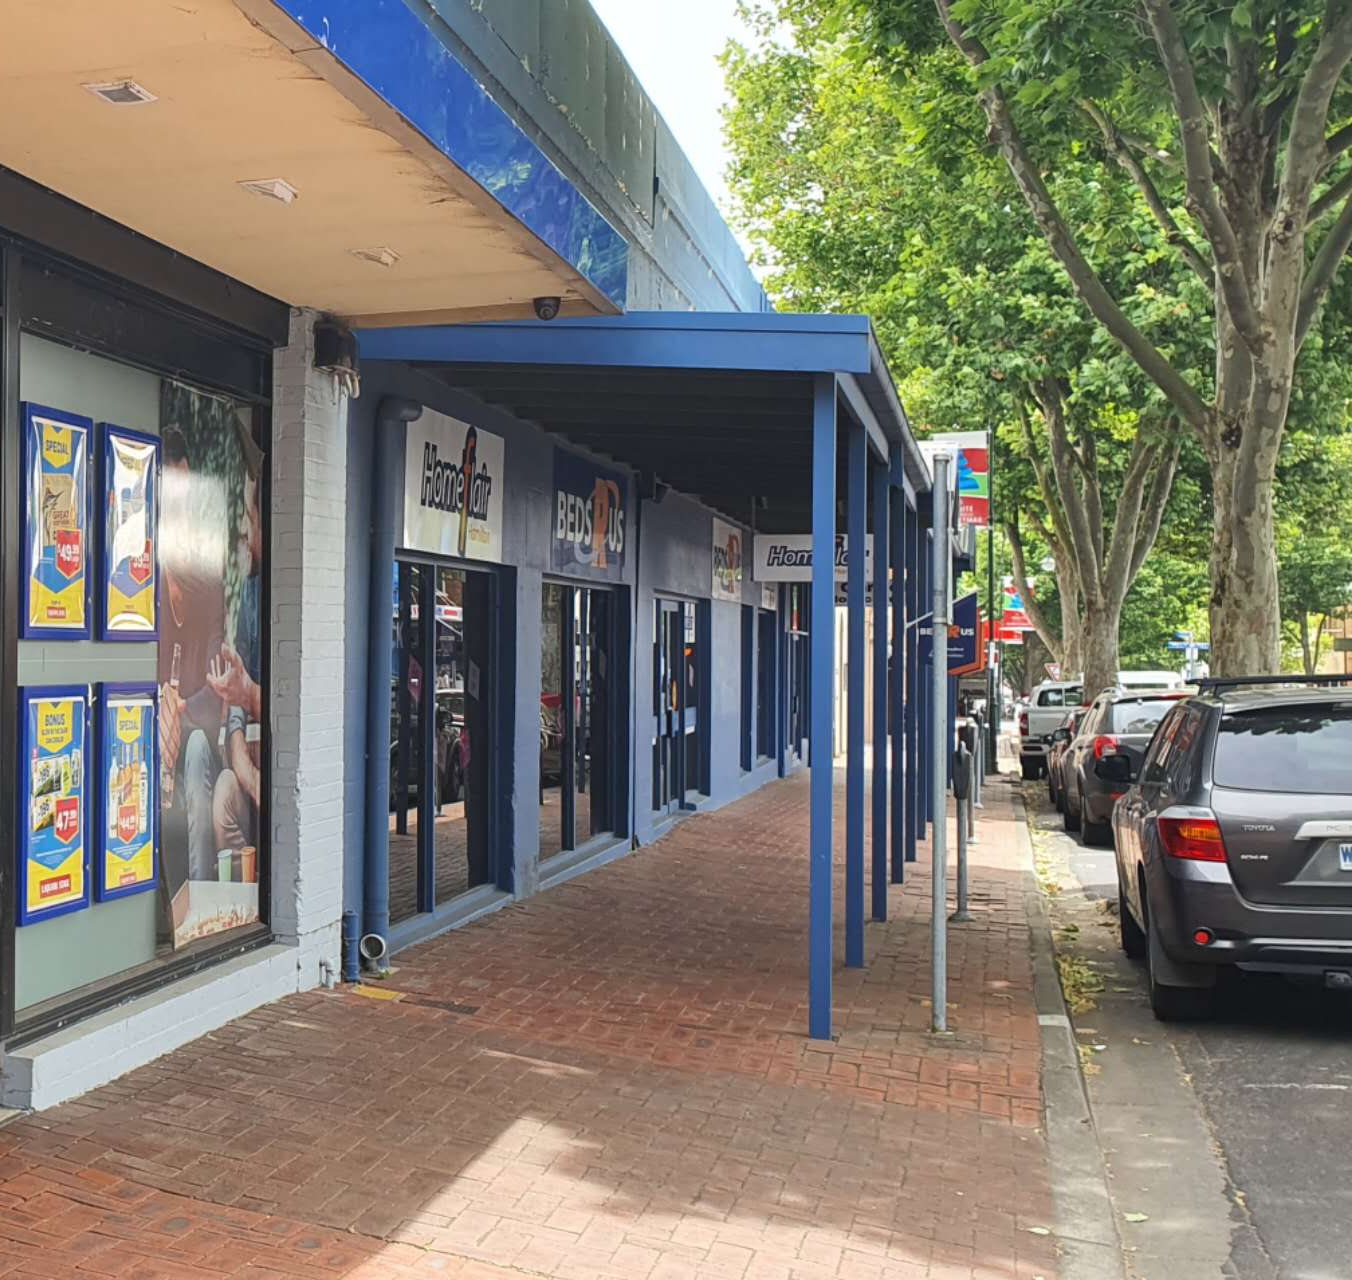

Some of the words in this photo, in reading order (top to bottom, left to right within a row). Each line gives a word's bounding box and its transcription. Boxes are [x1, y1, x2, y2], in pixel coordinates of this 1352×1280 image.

[556, 489, 592, 546] BEDS
[609, 507, 624, 553] US
[1242, 824, 1276, 832] TOYOTA
